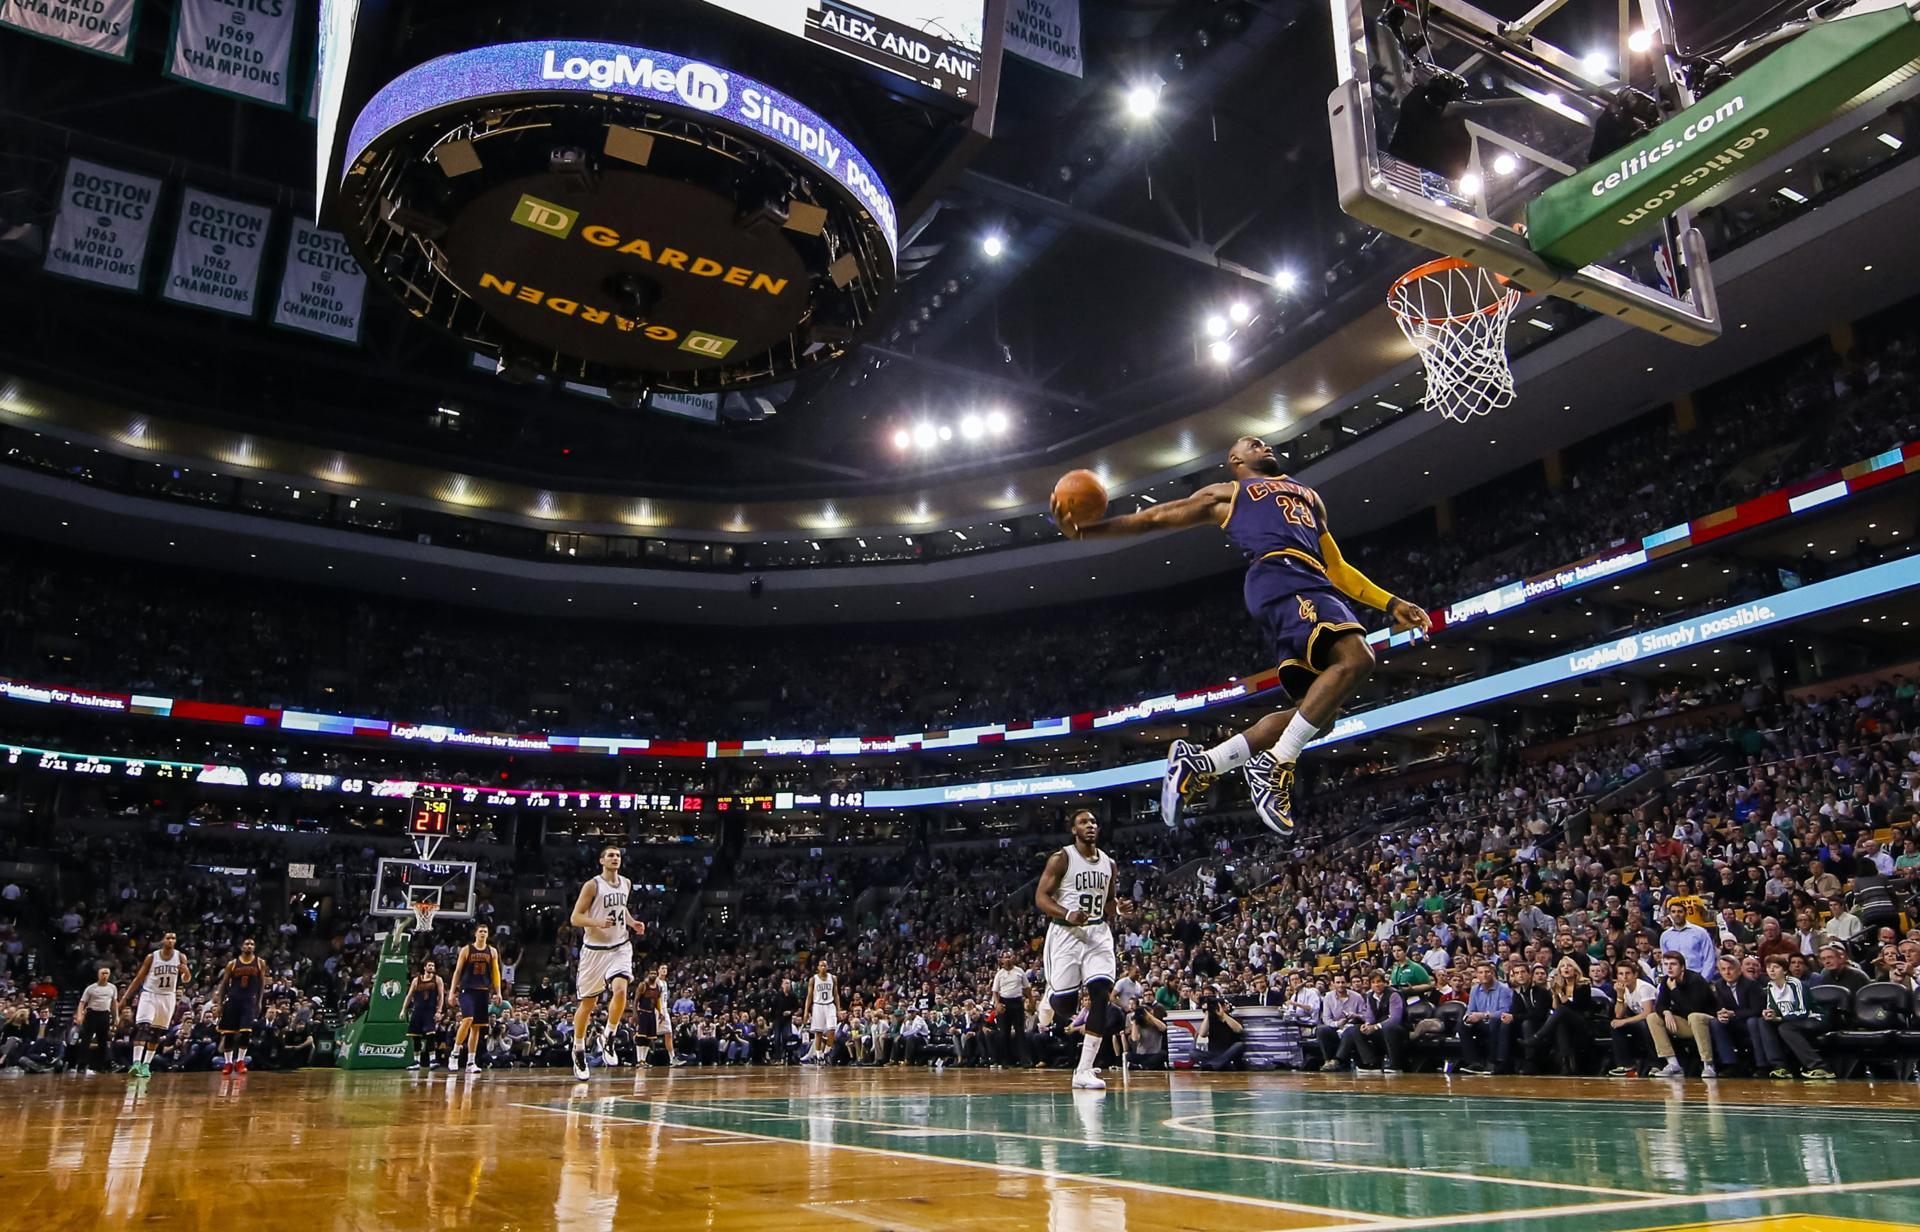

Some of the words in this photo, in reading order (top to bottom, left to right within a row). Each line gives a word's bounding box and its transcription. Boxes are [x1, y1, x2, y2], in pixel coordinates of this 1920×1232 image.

[1026, 0, 1052, 19] 1976
[219, 23, 255, 45] 1969
[1017, 9, 1062, 38] WORLD
[204, 36, 265, 65] WORLD
[821, 10, 877, 46] ALEX
[881, 32, 931, 64] AND
[934, 52, 972, 80] ANI
[183, 48, 281, 86] CHAMPIONS
[543, 50, 729, 111] LogMeIn
[741, 88, 842, 169] Simply
[1591, 96, 1744, 197] celtics.com
[1618, 127, 1770, 226] celtics.com
[72, 172, 151, 205] BOSTON
[71, 191, 144, 220] CELTICS
[189, 201, 263, 232] BOSTON
[86, 227, 117, 244] 1963
[188, 220, 256, 249] CELTICS
[297, 229, 350, 256] BOSTO
[73, 238, 124, 259] WORLD
[524, 200, 569, 231] TD
[582, 225, 789, 296] GARDEN
[53, 247, 136, 276] CHAMPIONS
[203, 255, 231, 271] 1962
[297, 247, 360, 275] CELTICS
[191, 265, 239, 286] WORLD
[173, 275, 250, 302] CHAMPIONS
[311, 282, 335, 297] 1961
[300, 292, 343, 312] WORLD
[480, 273, 678, 341] GARDEN
[283, 301, 354, 328] CHAMPIONS
[687, 335, 723, 355] TD
[1275, 495, 1316, 529] 23
[1555, 570, 1576, 587] for
[1642, 626, 1696, 652] Simply
[1701, 605, 1776, 639] possible.
[50, 690, 70, 702] for
[70, 692, 125, 709] business.
[447, 732, 492, 746] solutions
[492, 735, 508, 747] for
[508, 737, 551, 750] business.
[258, 772, 282, 787] 60
[341, 779, 363, 792] 65
[424, 801, 447, 813] 7:58
[684, 797, 702, 809] 22
[829, 793, 863, 807] 8:42
[416, 812, 443, 831] 21
[603, 893, 627, 909] CELTIC
[1079, 893, 1104, 916] 99
[158, 976, 171, 988] 11
[821, 991, 828, 1001] 0
[364, 1046, 406, 1054] PLAYOFFS
